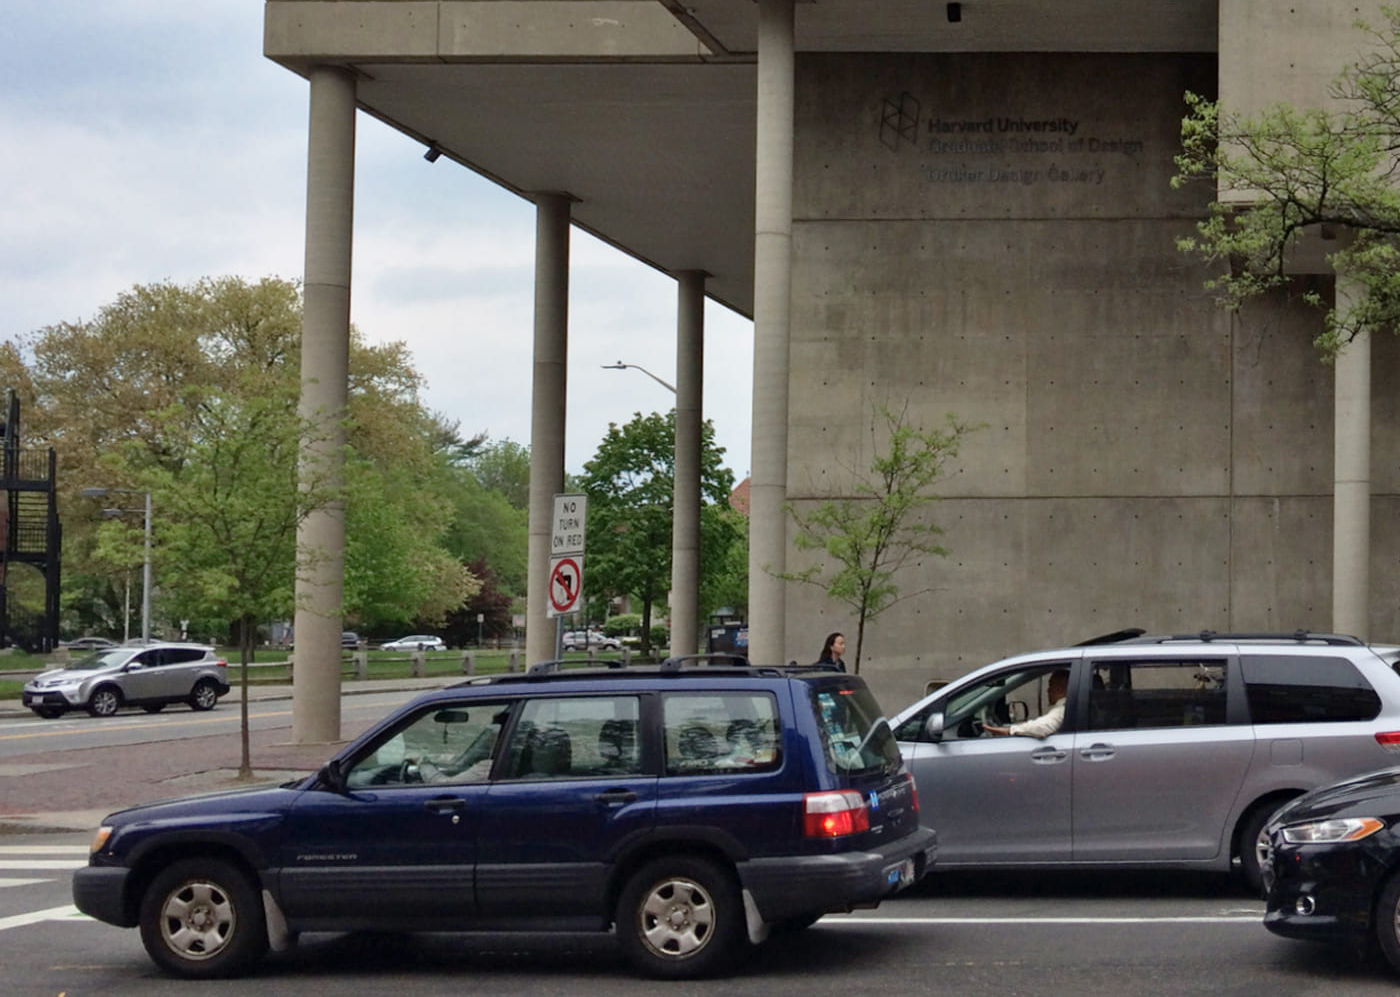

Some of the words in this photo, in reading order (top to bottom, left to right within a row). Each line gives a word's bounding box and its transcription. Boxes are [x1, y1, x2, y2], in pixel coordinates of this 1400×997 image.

[928, 118, 993, 133] Harvard
[997, 118, 1079, 136] University
[1088, 138, 1145, 156] Design
[563, 502, 576, 513] NO
[559, 518, 580, 531] TURN
[553, 536, 564, 548] ON
[567, 534, 582, 548] RED
